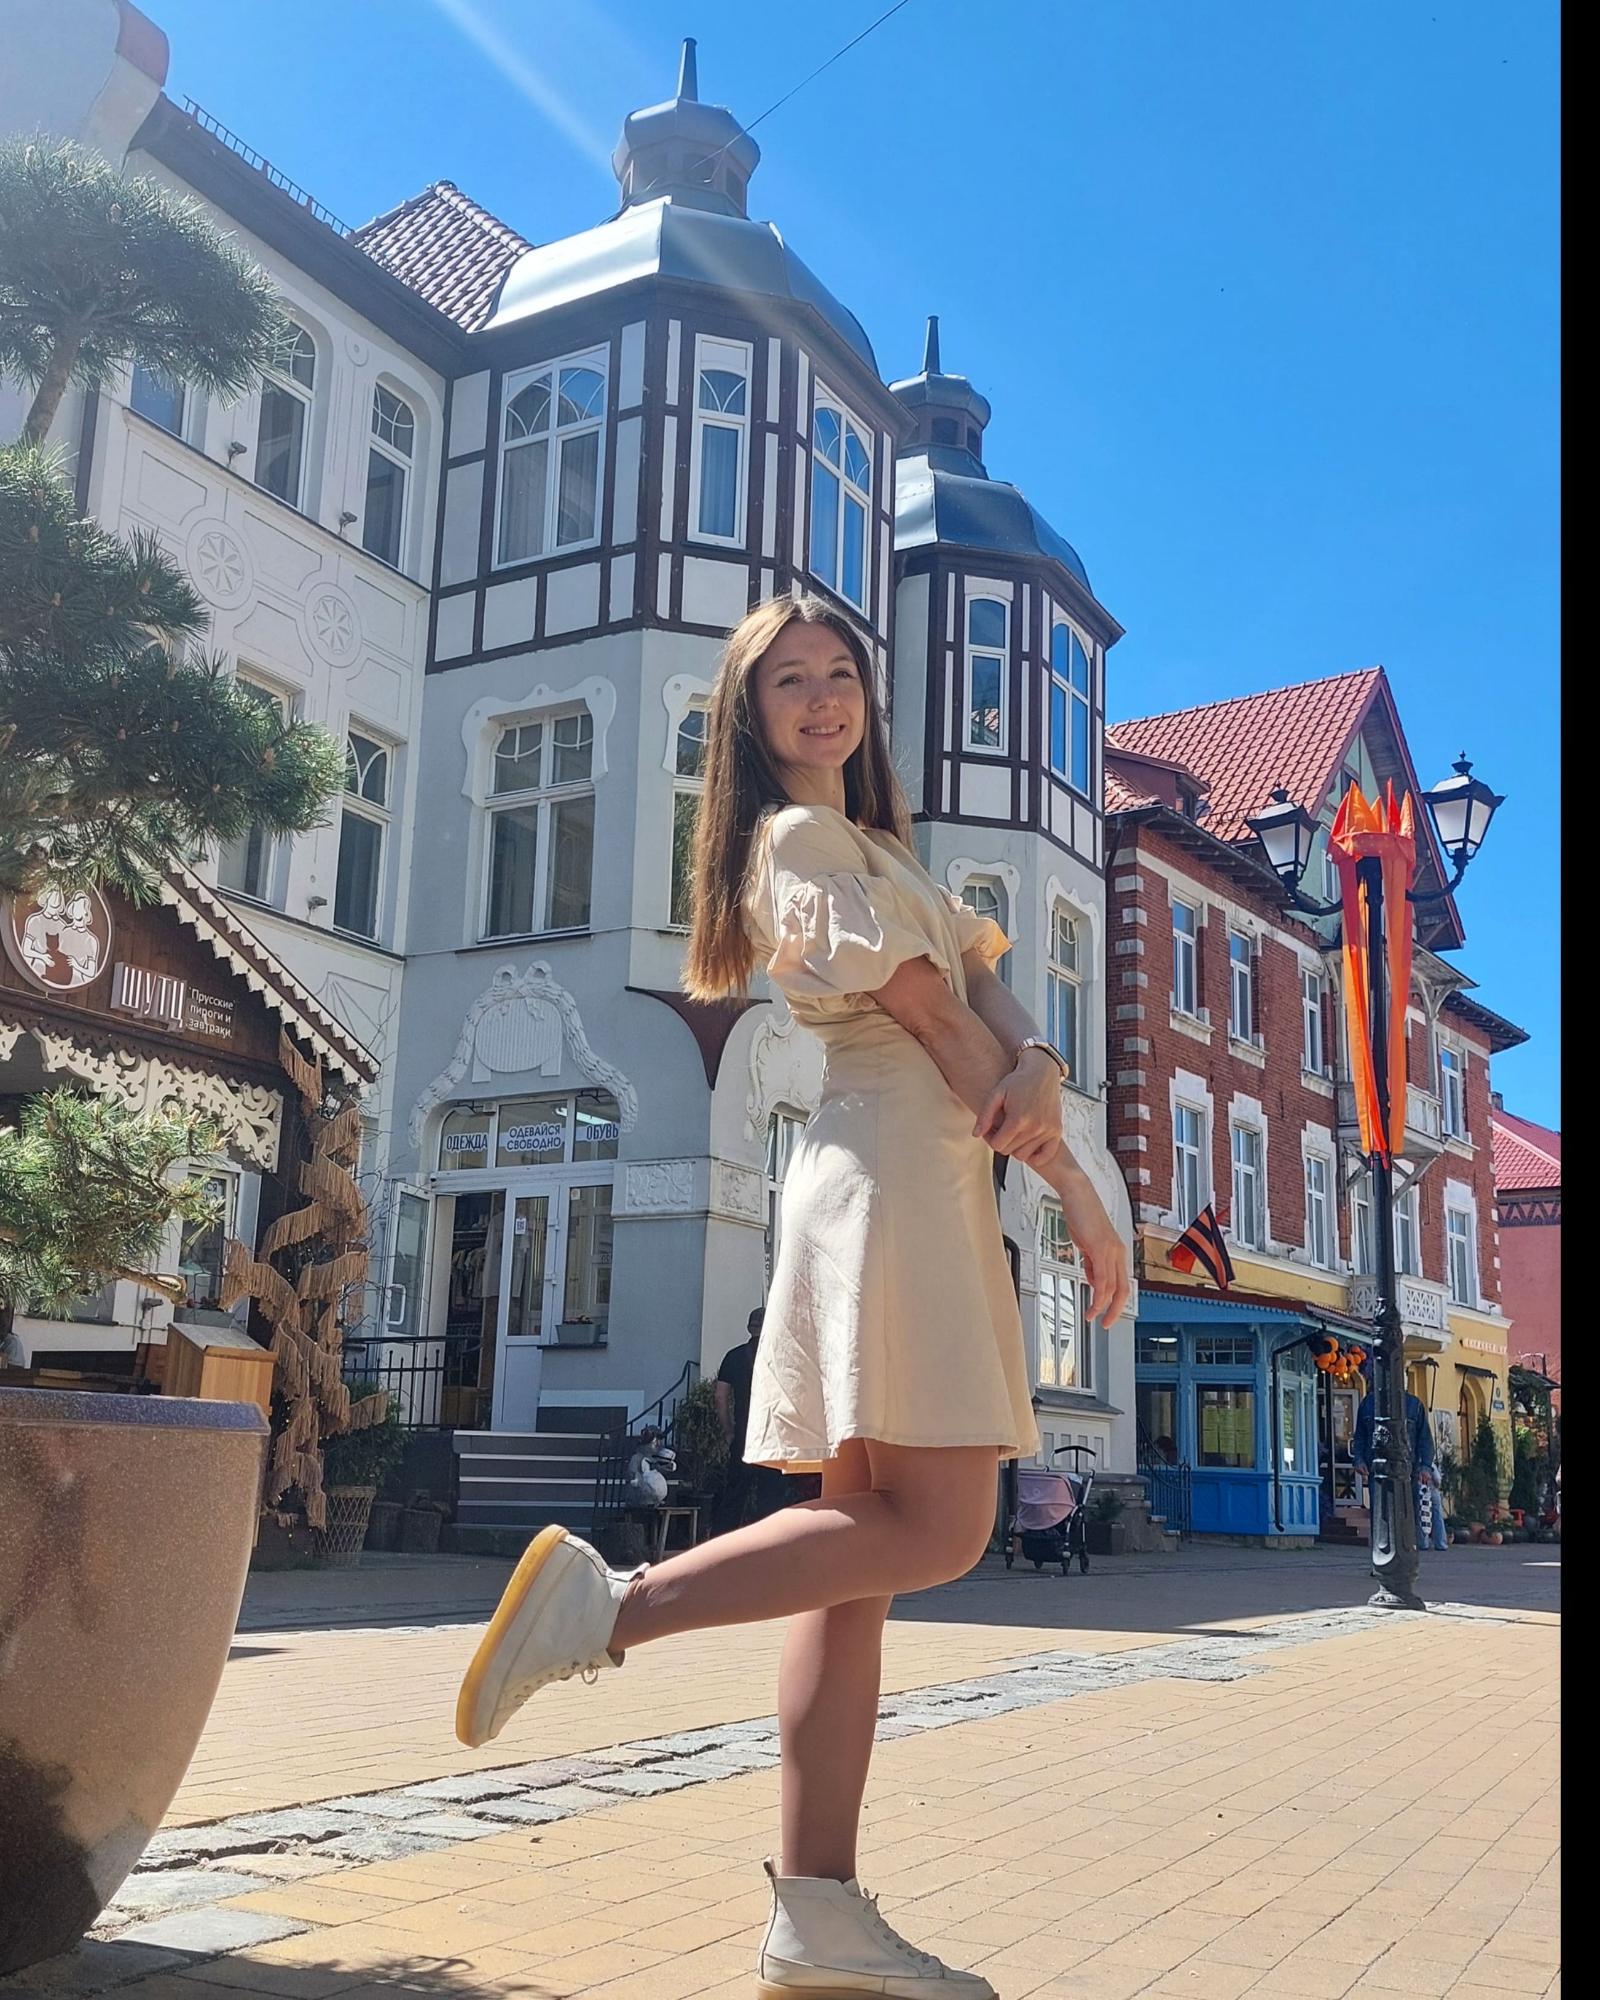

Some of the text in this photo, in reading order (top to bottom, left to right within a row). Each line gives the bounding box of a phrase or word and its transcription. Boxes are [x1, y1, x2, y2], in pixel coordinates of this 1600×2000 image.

[191, 988, 234, 1010] Прусские
[190, 1004, 231, 1024] пироги и
[188, 1018, 231, 1038] завтраки
[509, 1124, 561, 1139] ОДЕВАЙСЯ
[586, 1124, 619, 1140] ОБУВЬ
[446, 1134, 488, 1151] ОДЕЖДА
[506, 1137, 561, 1151] СВОБОДНО
